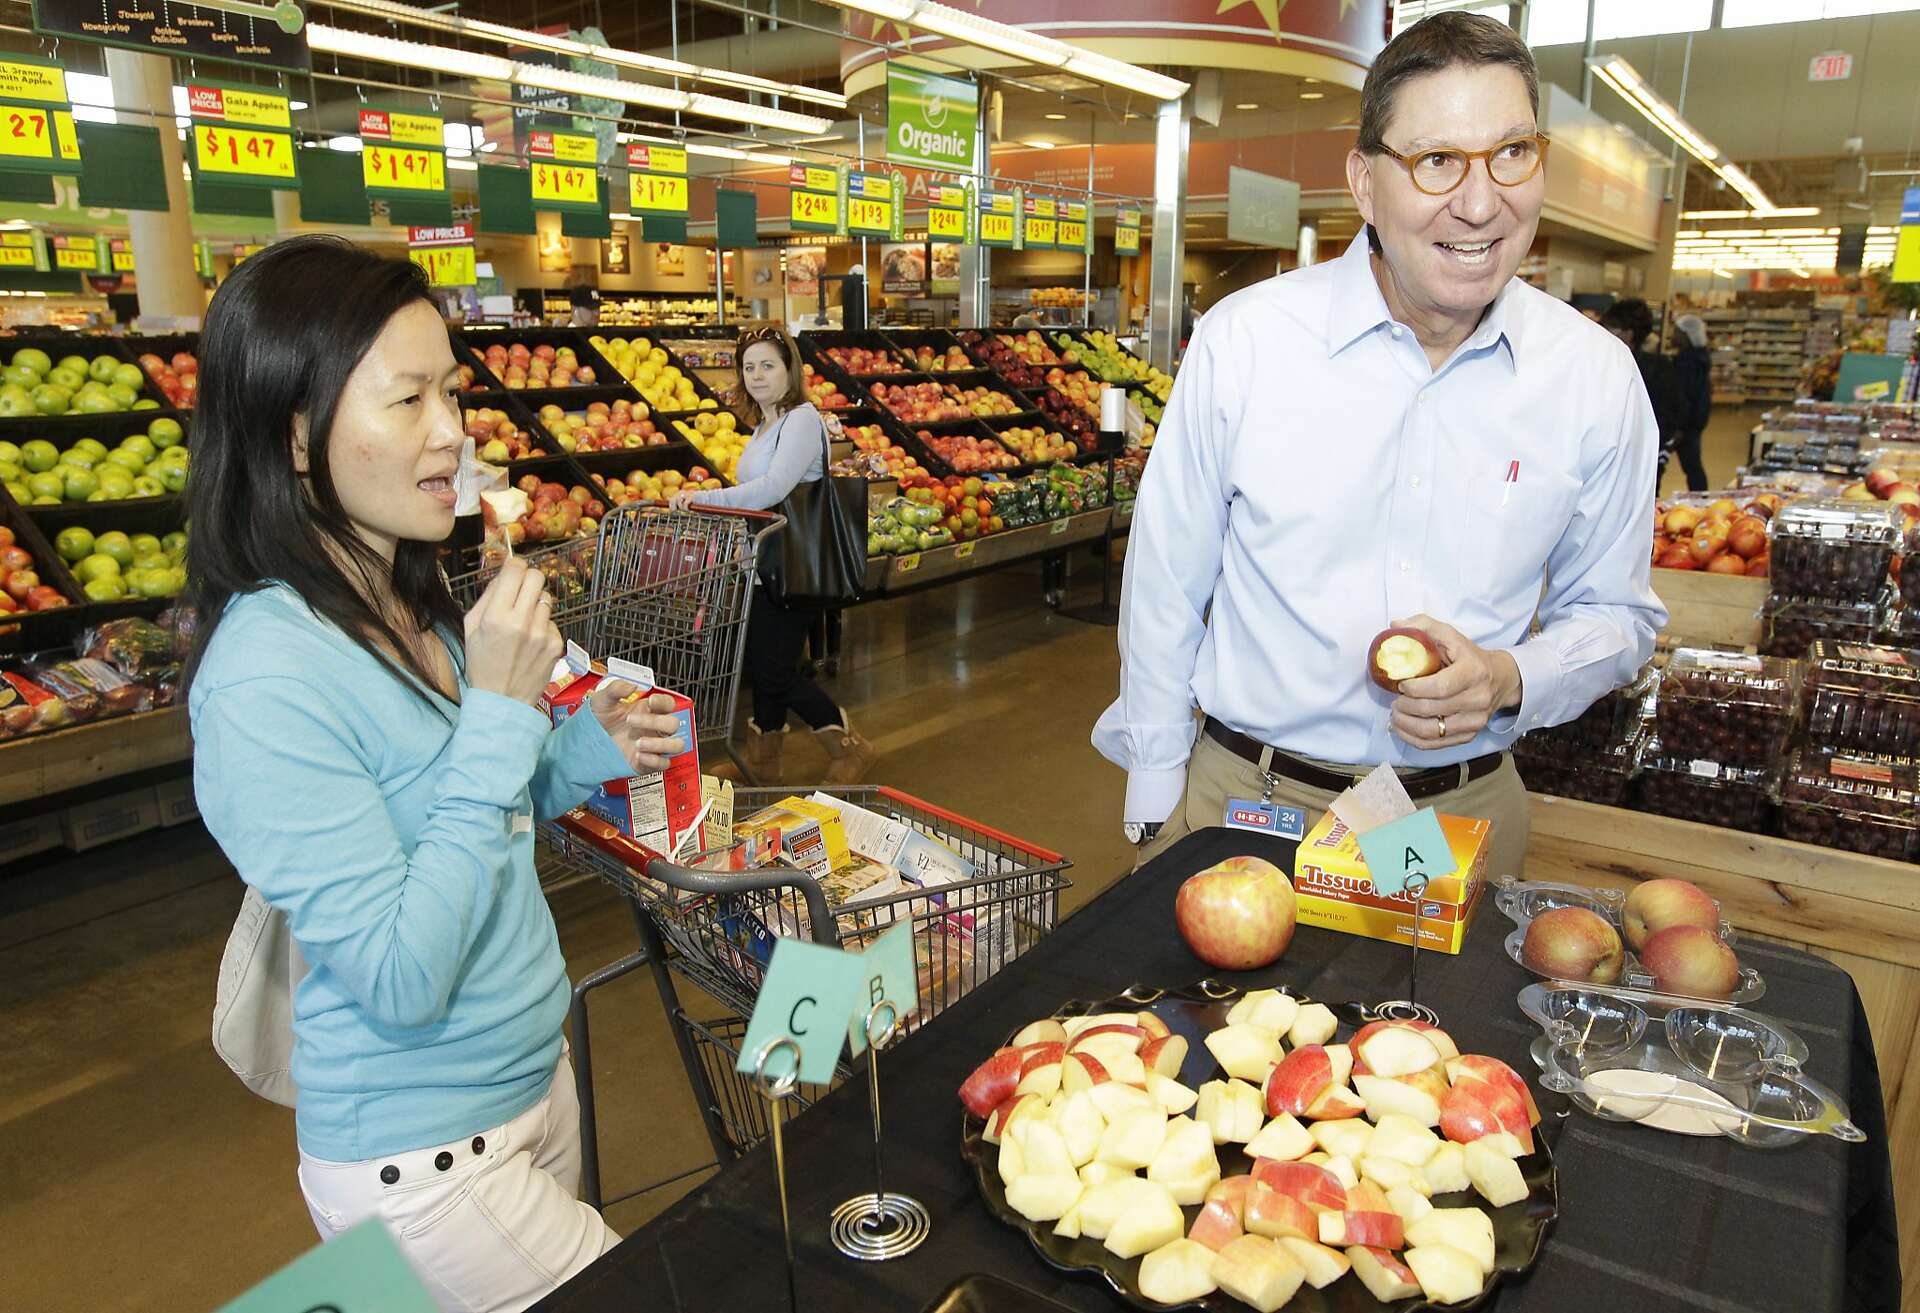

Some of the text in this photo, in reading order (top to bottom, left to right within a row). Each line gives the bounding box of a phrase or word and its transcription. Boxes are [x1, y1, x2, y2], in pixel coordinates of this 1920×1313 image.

[194, 90, 217, 100] LOW
[191, 98, 222, 110] PRICES
[226, 96, 285, 111] Gala Apples
[361, 120, 388, 131] PRICES
[364, 114, 384, 122] LOW
[898, 122, 966, 158] Organic
[415, 226, 465, 241] LOW PRICES
[1281, 812, 1296, 824] 24
[1404, 846, 1425, 870] A
[869, 975, 884, 1007] B
[789, 996, 817, 1036] C
